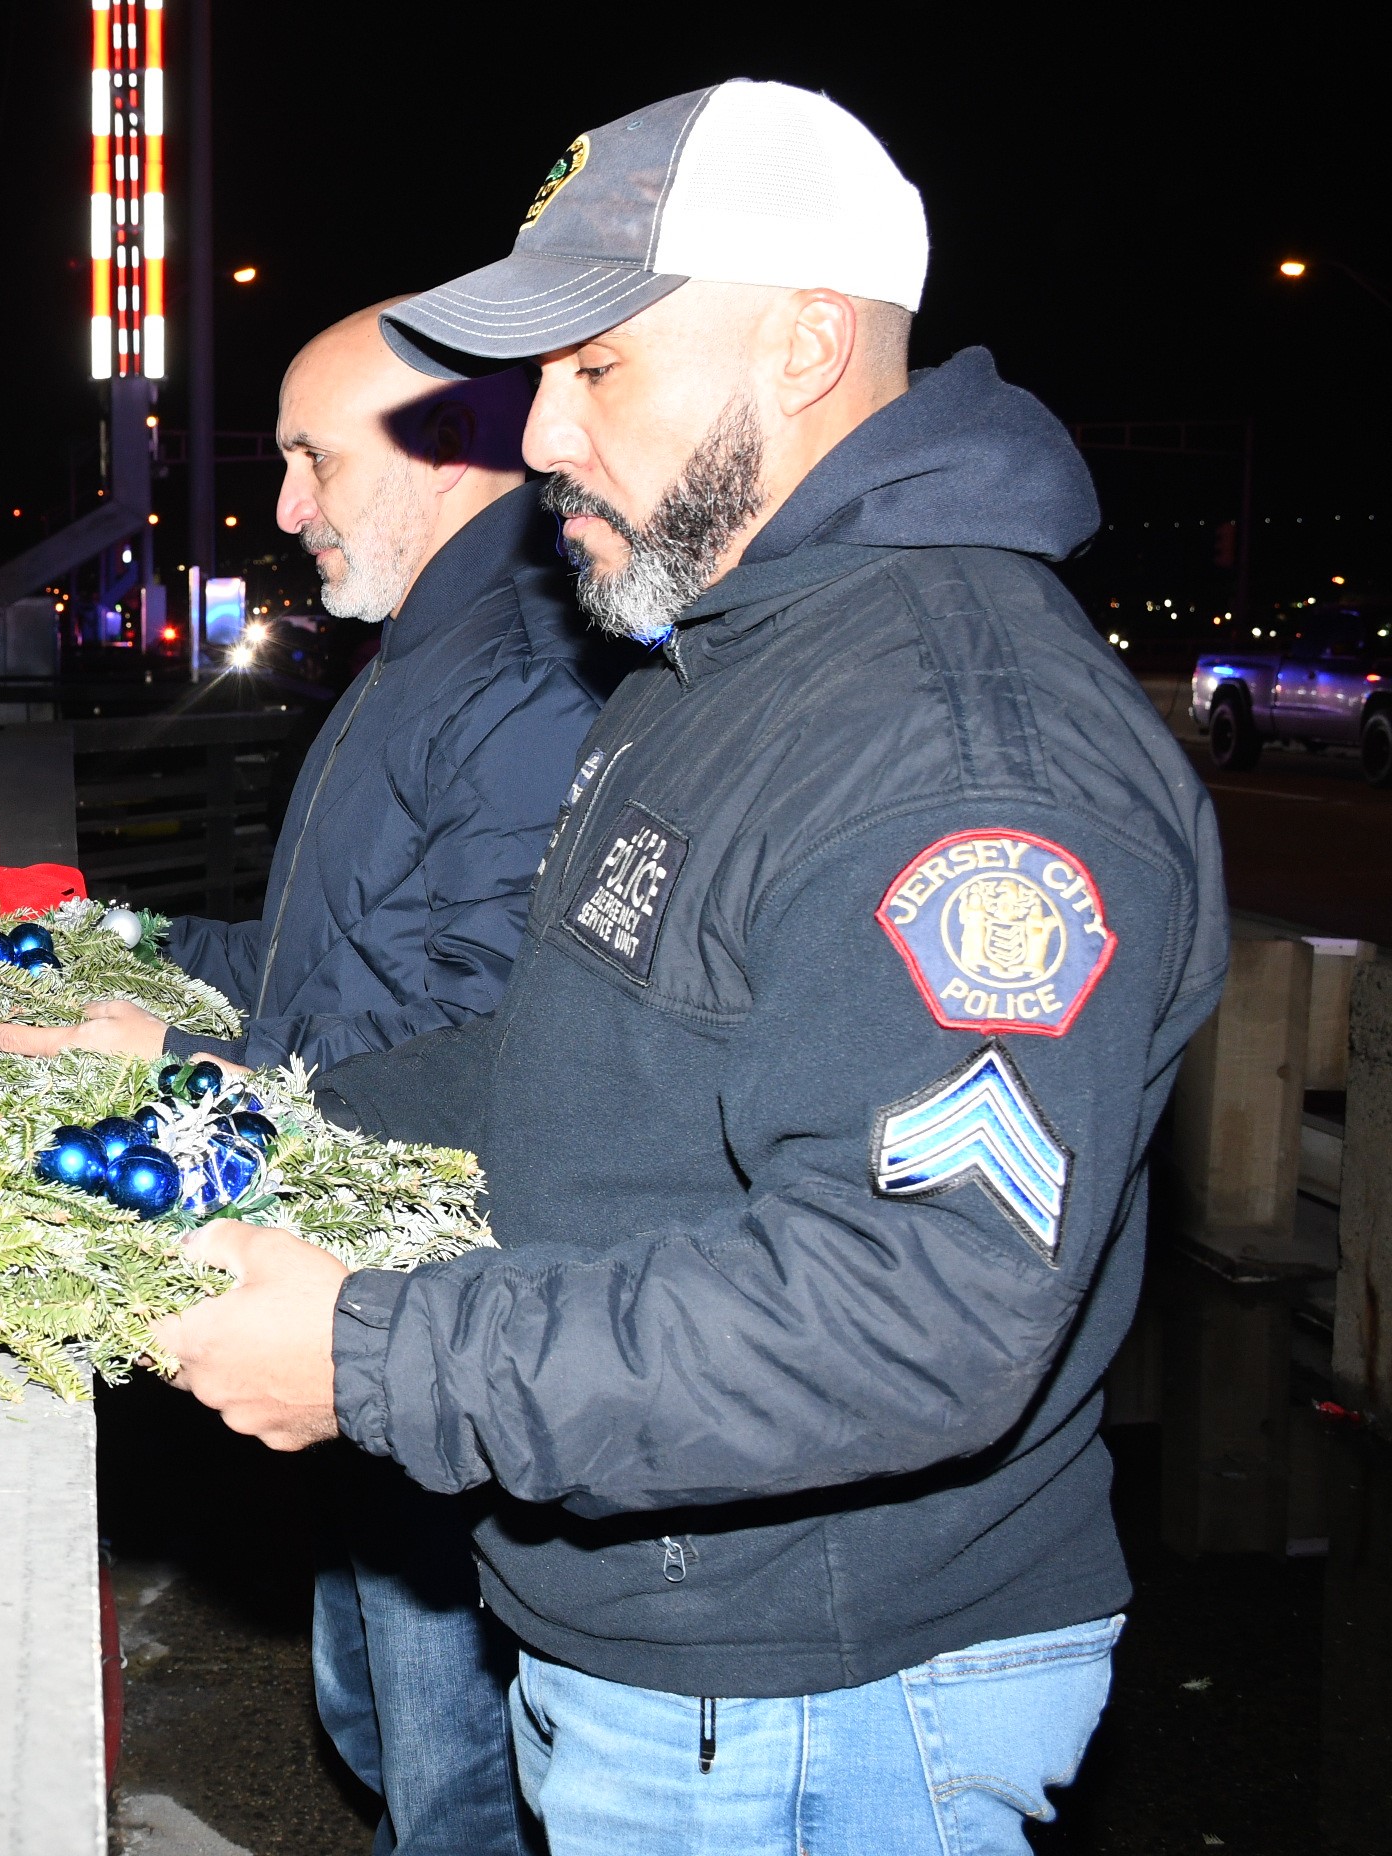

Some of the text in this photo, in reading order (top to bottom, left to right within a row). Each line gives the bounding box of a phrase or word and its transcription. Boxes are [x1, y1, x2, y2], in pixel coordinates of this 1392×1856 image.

[597, 837, 667, 916] POLICE
[890, 839, 1108, 939] JERSEY CITY
[577, 902, 640, 958] SERVICE UNIT
[591, 886, 641, 932] EMERGENCY
[940, 977, 1063, 1020] POLICE
